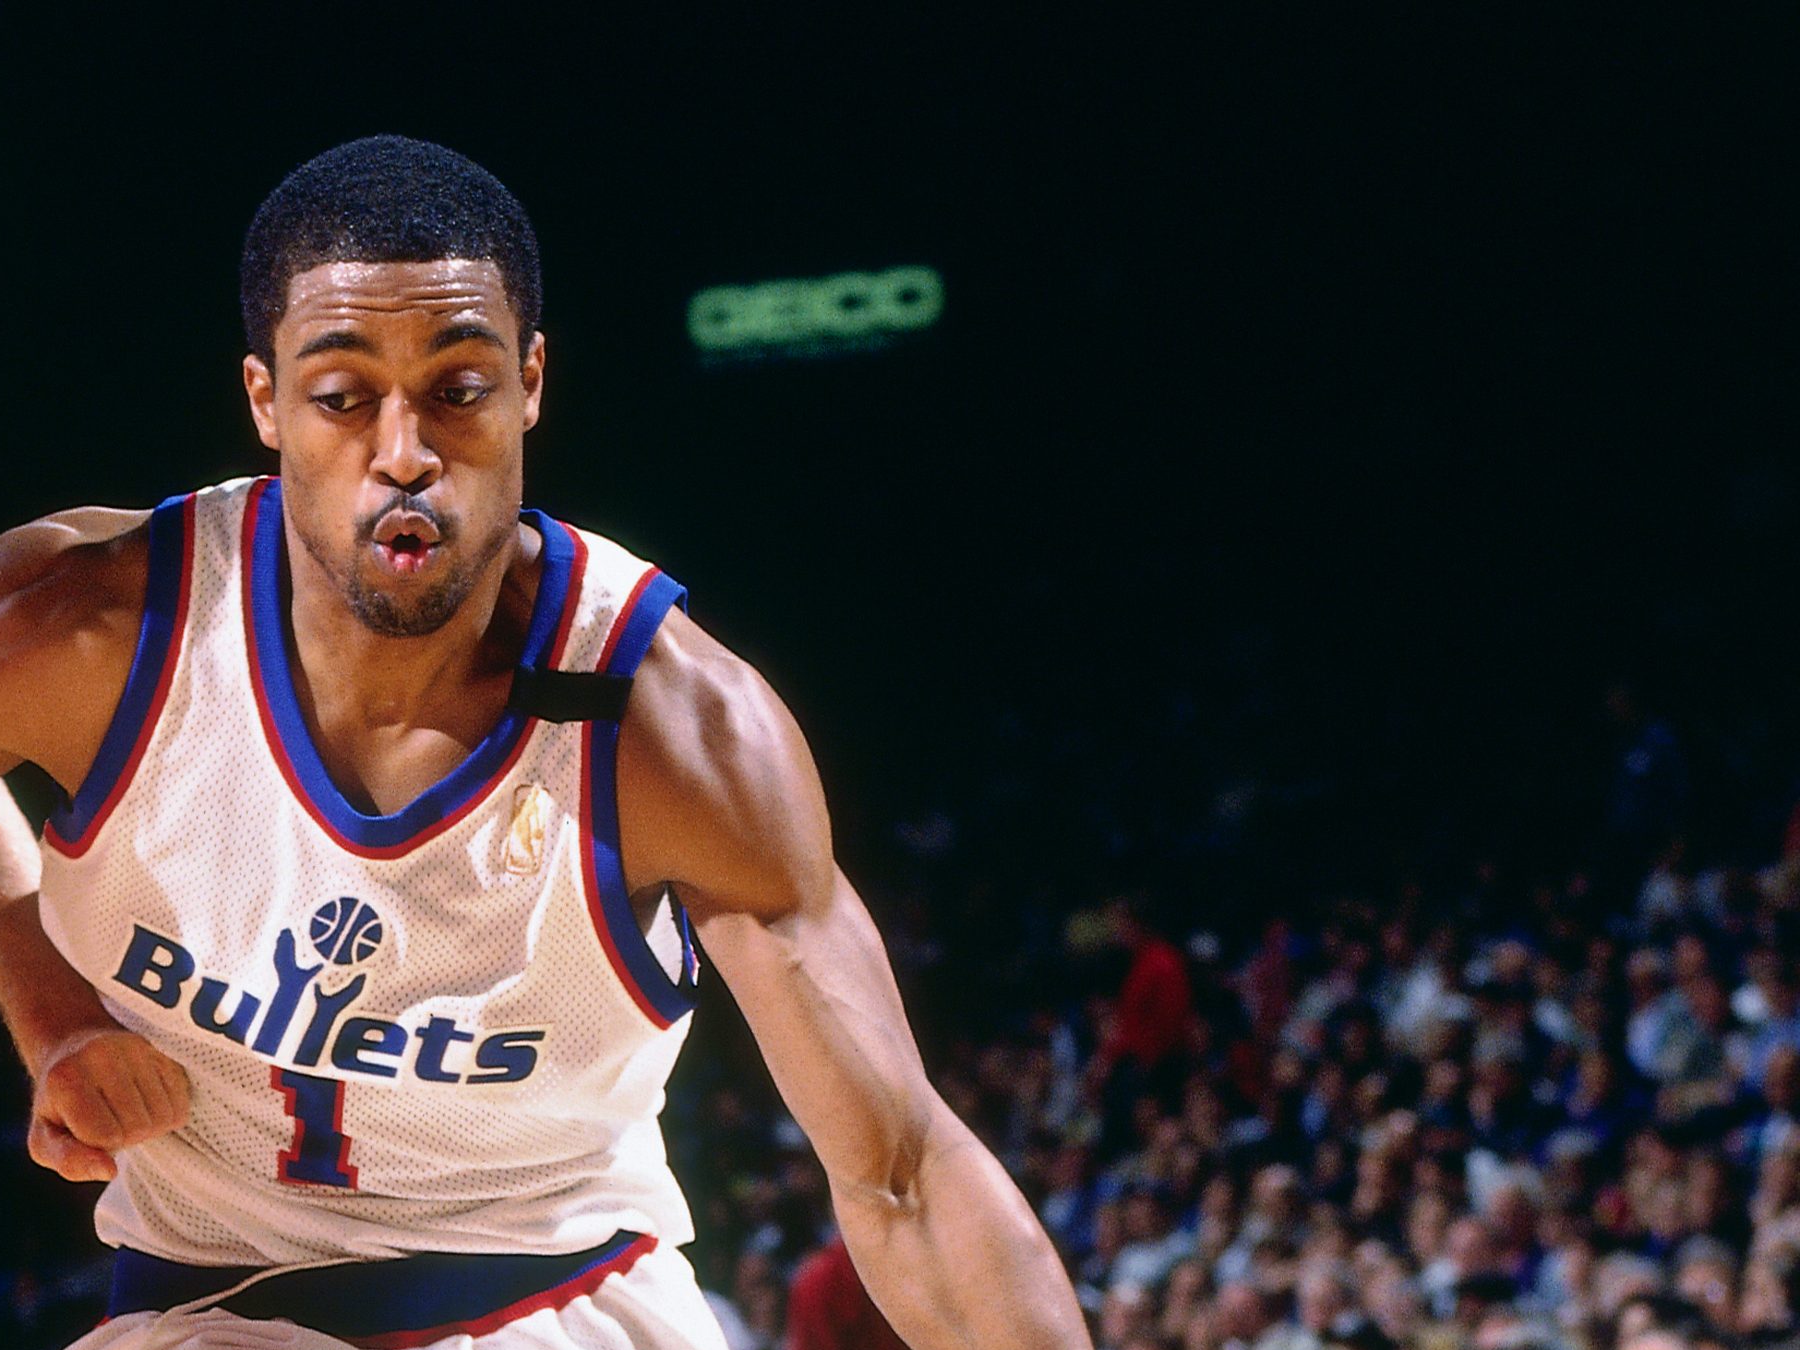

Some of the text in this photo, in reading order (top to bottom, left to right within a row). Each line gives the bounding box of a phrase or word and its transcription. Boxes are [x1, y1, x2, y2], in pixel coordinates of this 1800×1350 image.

[688, 265, 943, 347] GEICO
[113, 923, 546, 1085] Bullets
[271, 1066, 359, 1190] 1
